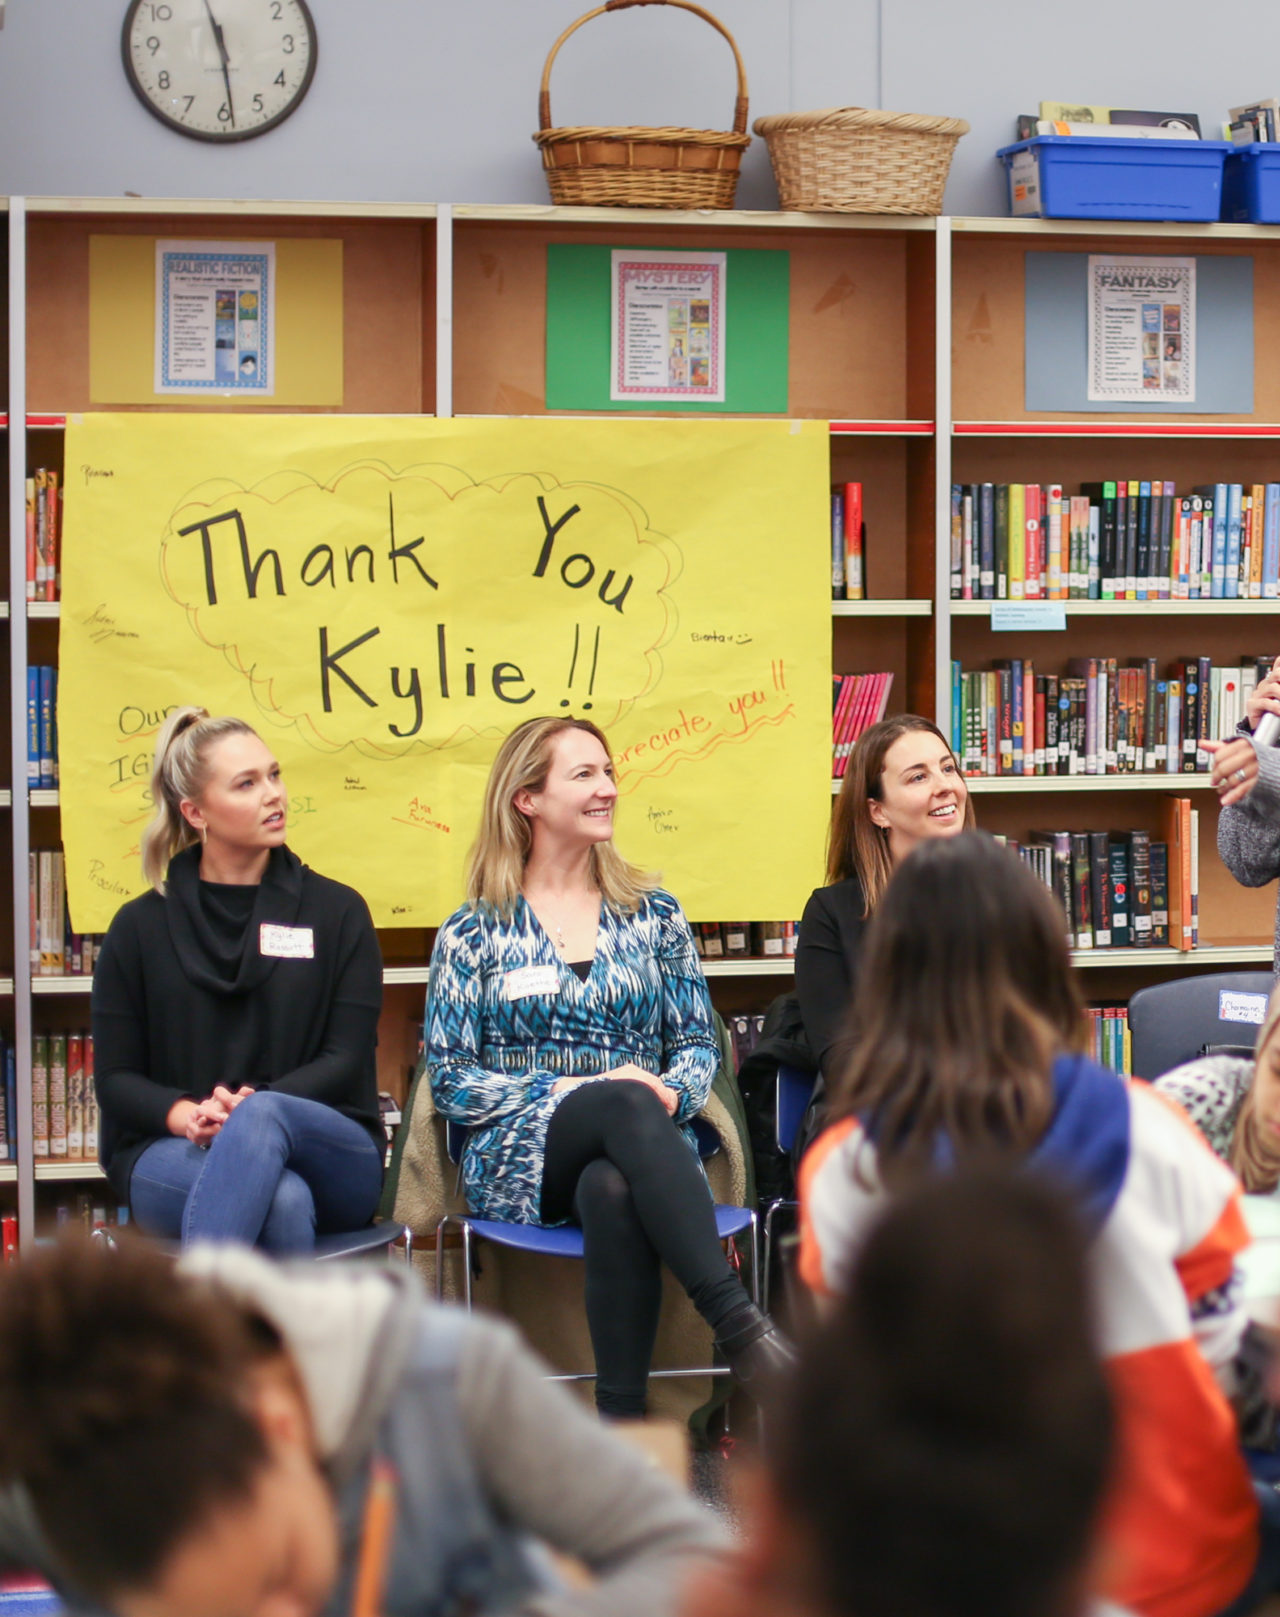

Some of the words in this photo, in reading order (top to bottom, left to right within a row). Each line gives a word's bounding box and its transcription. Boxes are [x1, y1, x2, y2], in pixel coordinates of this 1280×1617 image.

[151, 4, 172, 22] 10
[270, 2, 282, 20] 2
[146, 36, 160, 56] 9
[282, 34, 294, 54] 3
[158, 70, 170, 90] 8
[273, 69, 286, 87] 4
[183, 95, 195, 113] 7
[217, 102, 230, 122] 6
[252, 94, 263, 112] 5
[221, 262, 260, 275] FICTION
[624, 270, 711, 284] MYSTERY
[1101, 275, 1182, 289] FANTASY
[177, 490, 439, 606] Thank
[532, 495, 634, 614] You
[319, 623, 536, 737] Kylie
[1201, 682, 1209, 715] RACING
[728, 690, 766, 734] you
